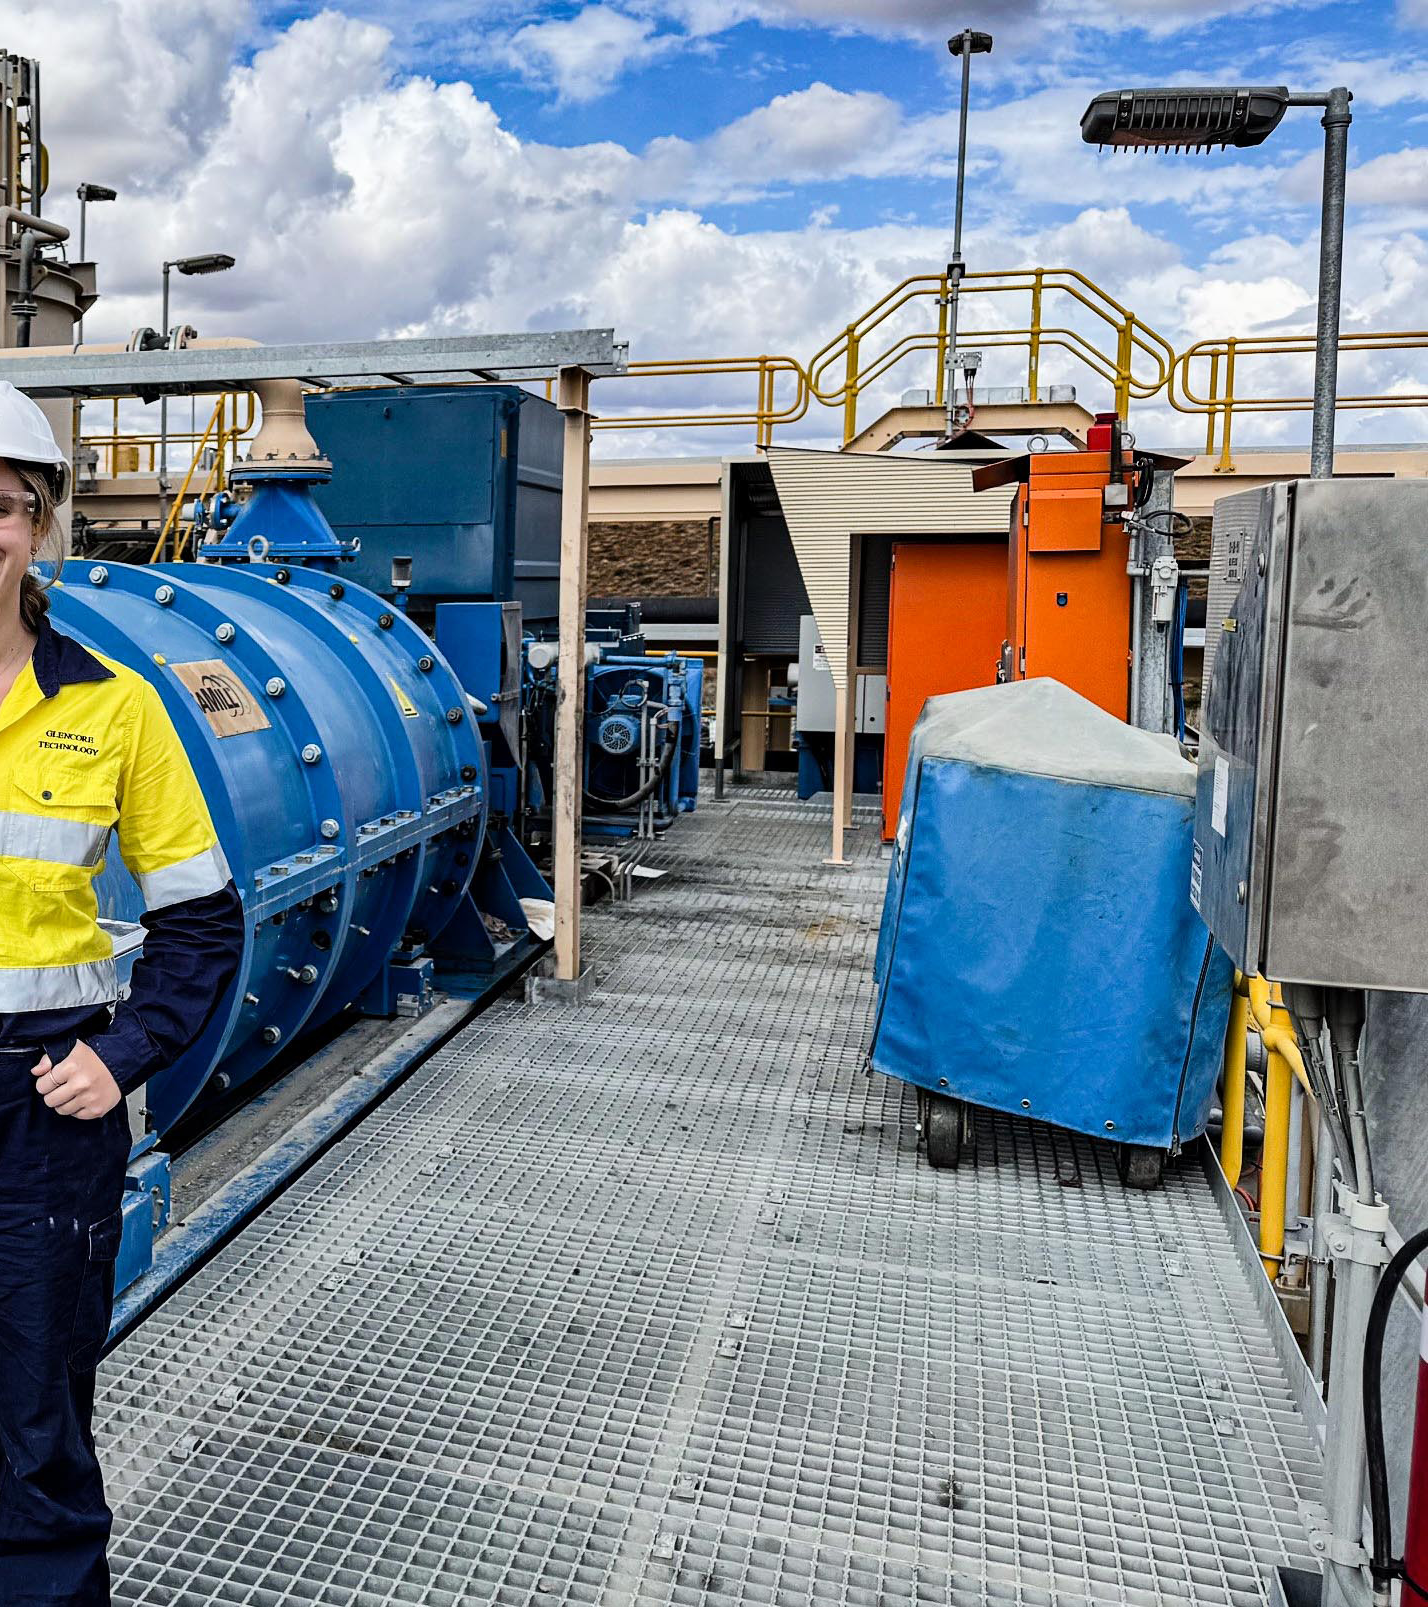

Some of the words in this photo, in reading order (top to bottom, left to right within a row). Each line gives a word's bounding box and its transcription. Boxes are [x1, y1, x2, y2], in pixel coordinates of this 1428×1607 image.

[190, 686, 241, 713] AMILL
[45, 730, 94, 743] GLENCORE
[38, 741, 99, 756] TECHNOLOGY
